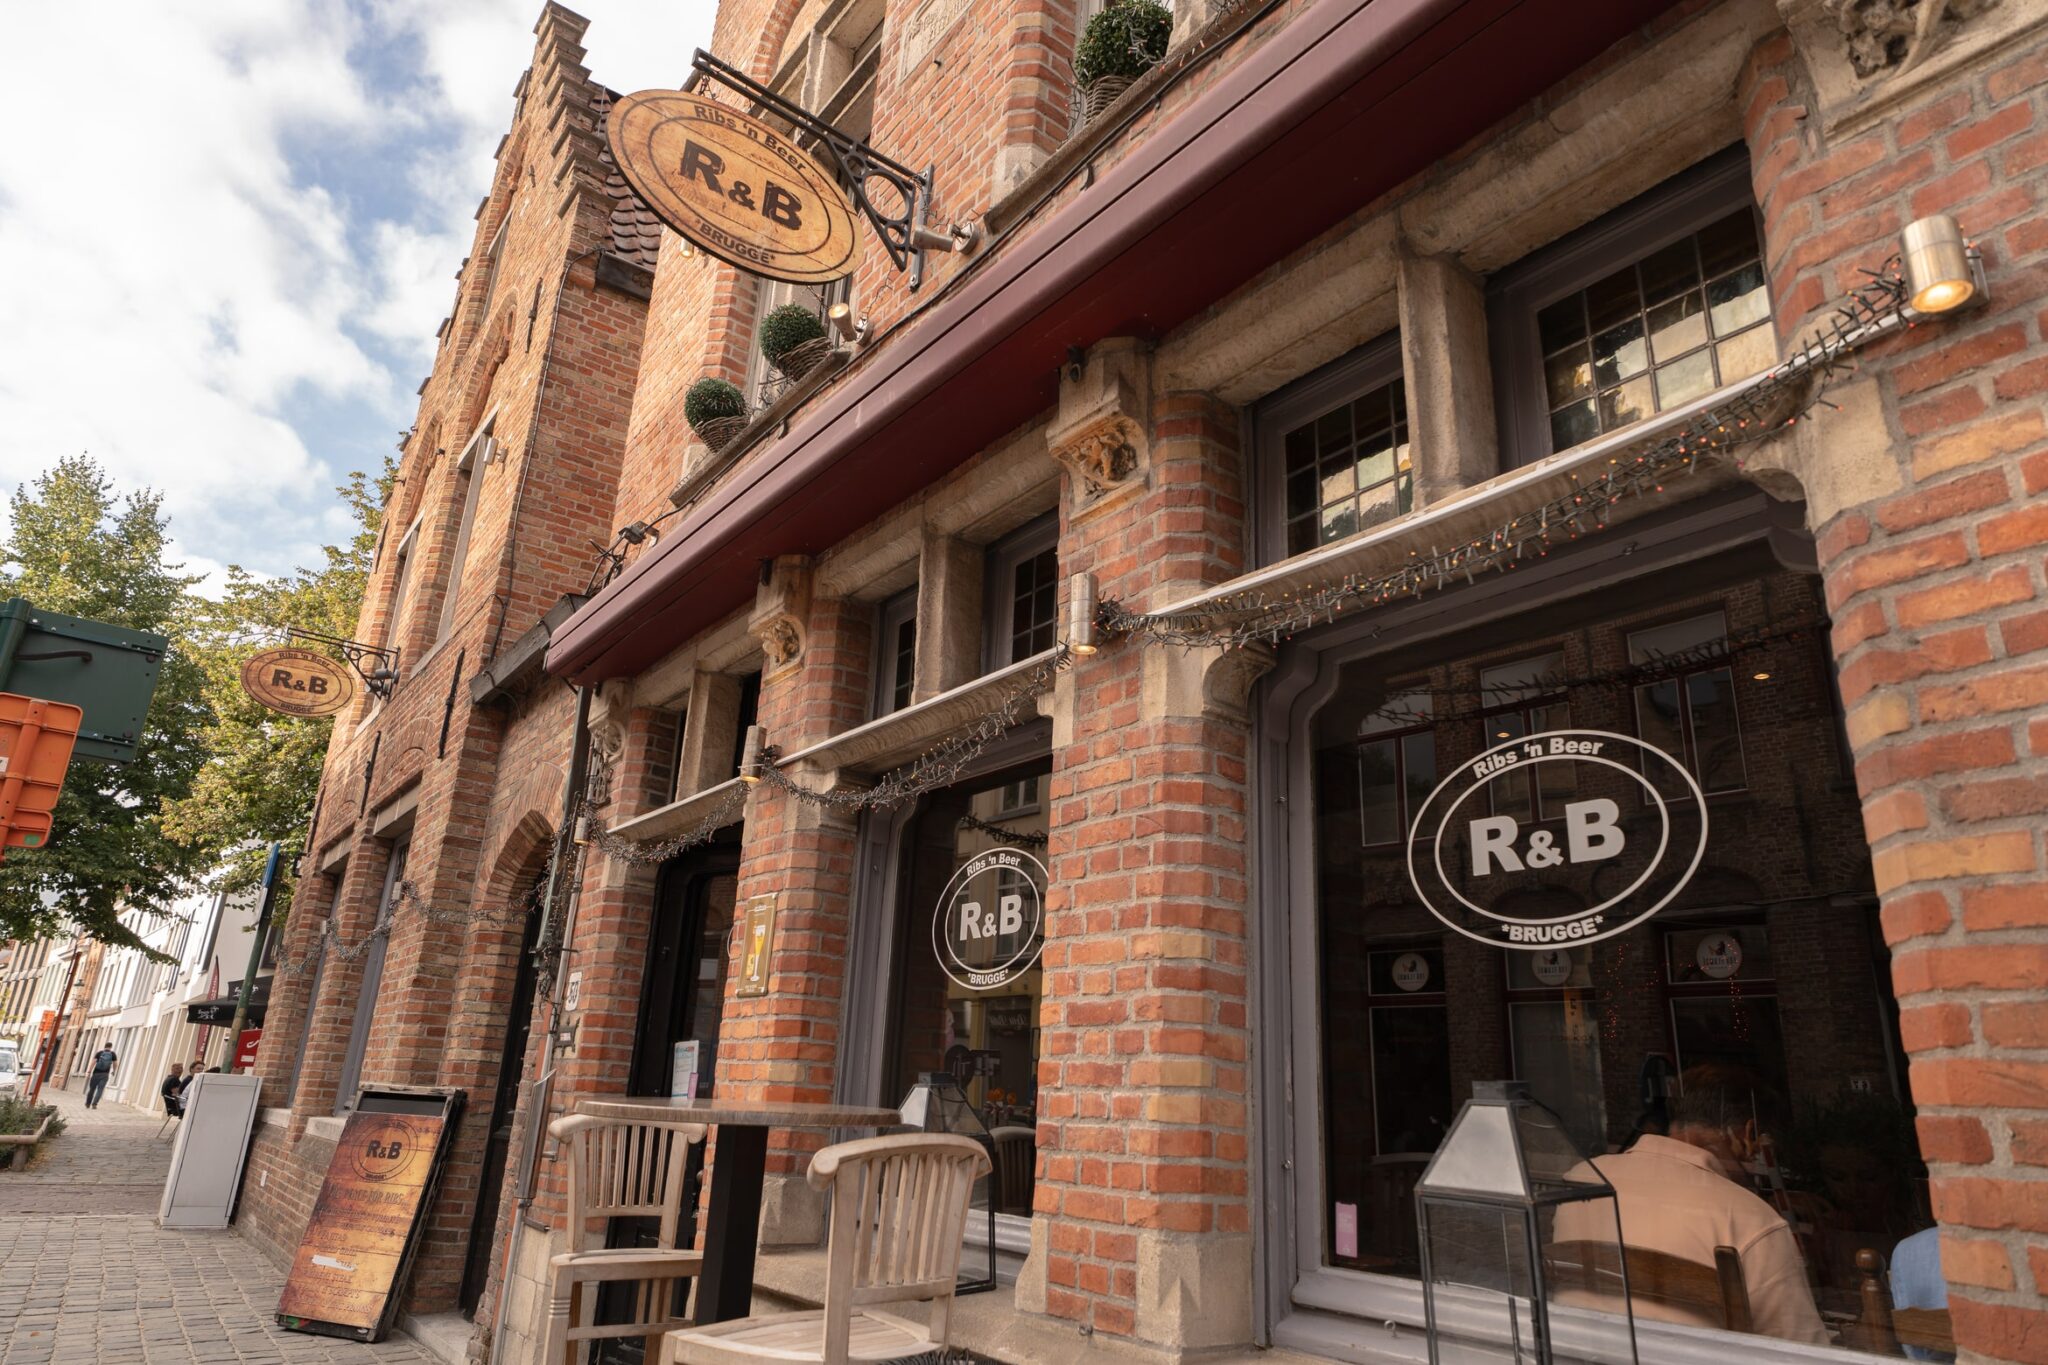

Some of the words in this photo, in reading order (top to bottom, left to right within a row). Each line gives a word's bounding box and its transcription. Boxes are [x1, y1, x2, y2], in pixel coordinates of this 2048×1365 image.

[694, 105, 736, 129] Ribs
[765, 134, 807, 172] Beer
[680, 138, 802, 231] R&B
[279, 652, 298, 660] Ribs
[272, 668, 328, 695] R&B
[1472, 749, 1518, 779] Ribs
[1550, 737, 1604, 756] Beer
[1469, 798, 1625, 877] R&B
[966, 859, 986, 877] Ribs
[999, 853, 1020, 867] Beer
[960, 894, 1022, 941] R&B
[366, 1140, 402, 1159] R&B
